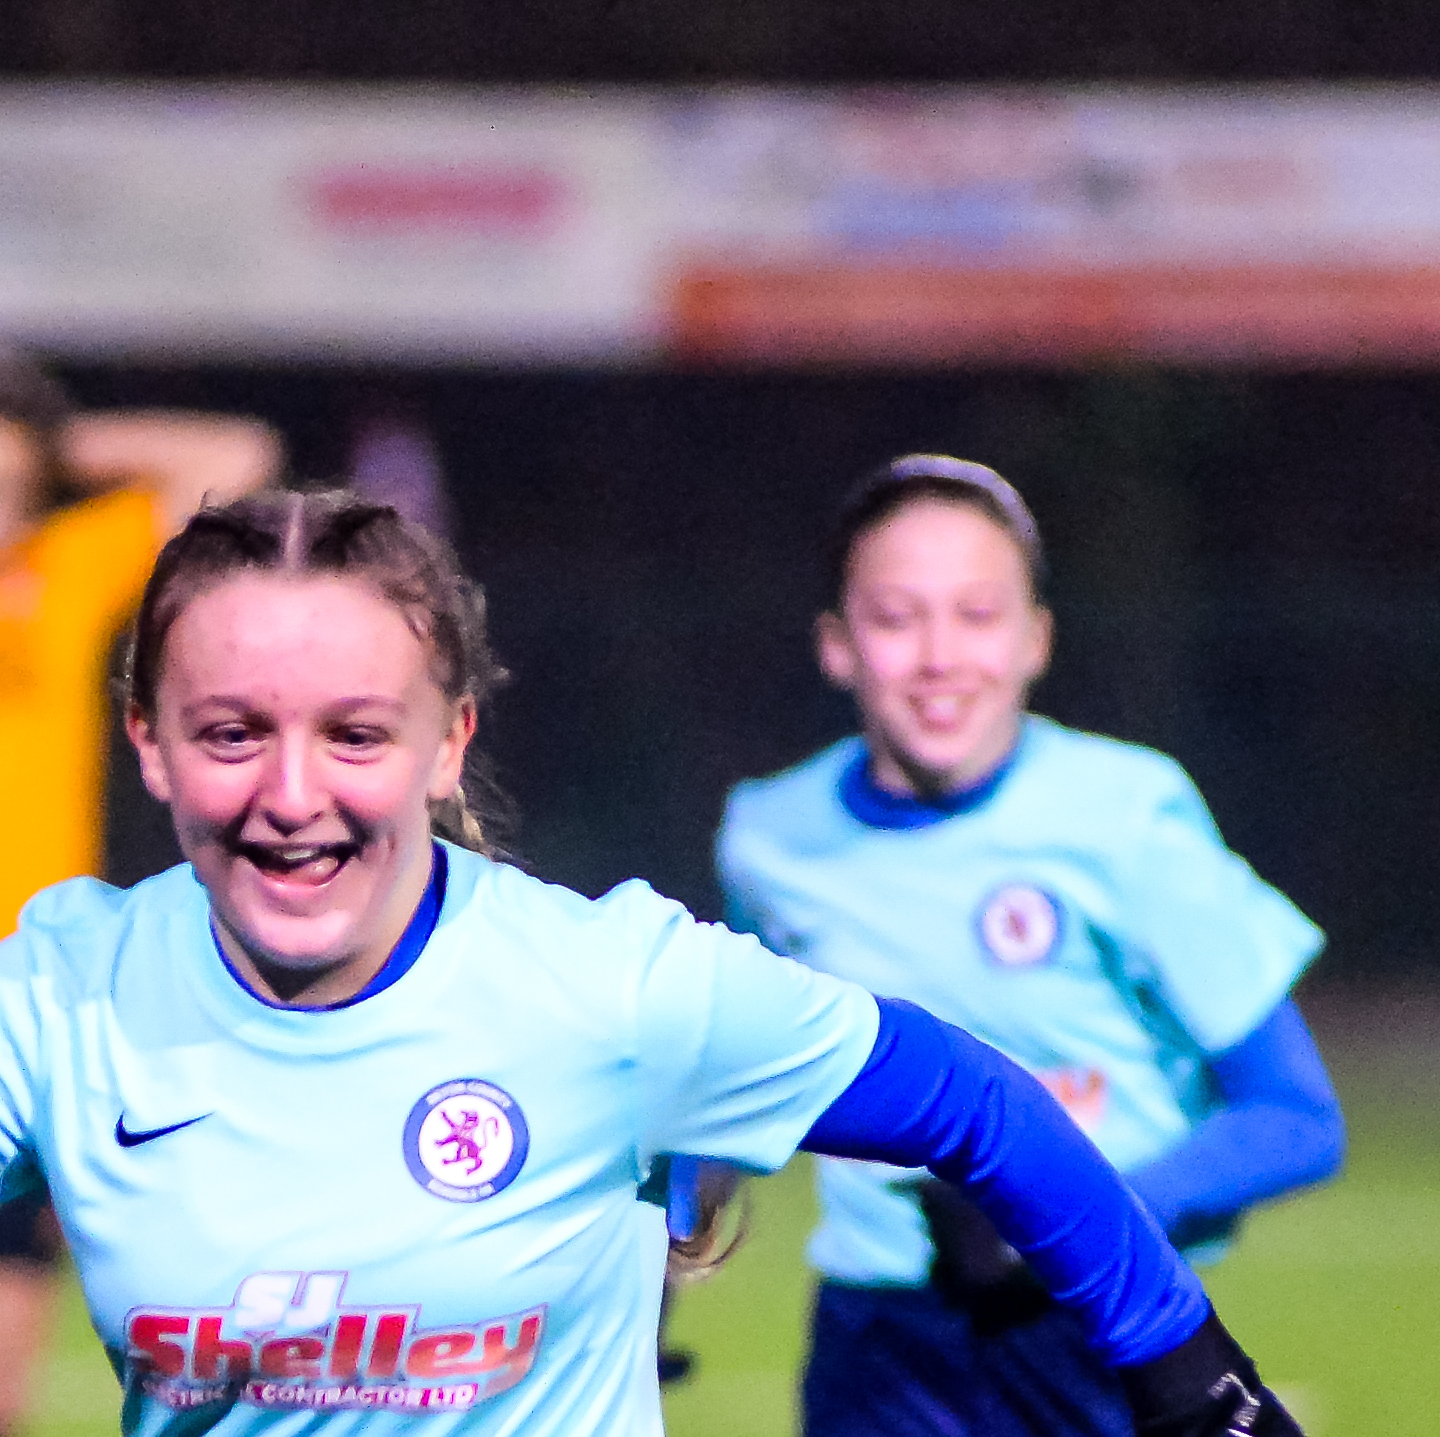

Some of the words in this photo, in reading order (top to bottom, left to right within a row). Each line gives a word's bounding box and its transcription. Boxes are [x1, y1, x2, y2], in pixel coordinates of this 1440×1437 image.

[235, 1274, 338, 1327] SJ
[129, 1313, 539, 1397] Shelley
[261, 1383, 422, 1408] CONTRACTOR
[428, 1383, 477, 1407] LTD
